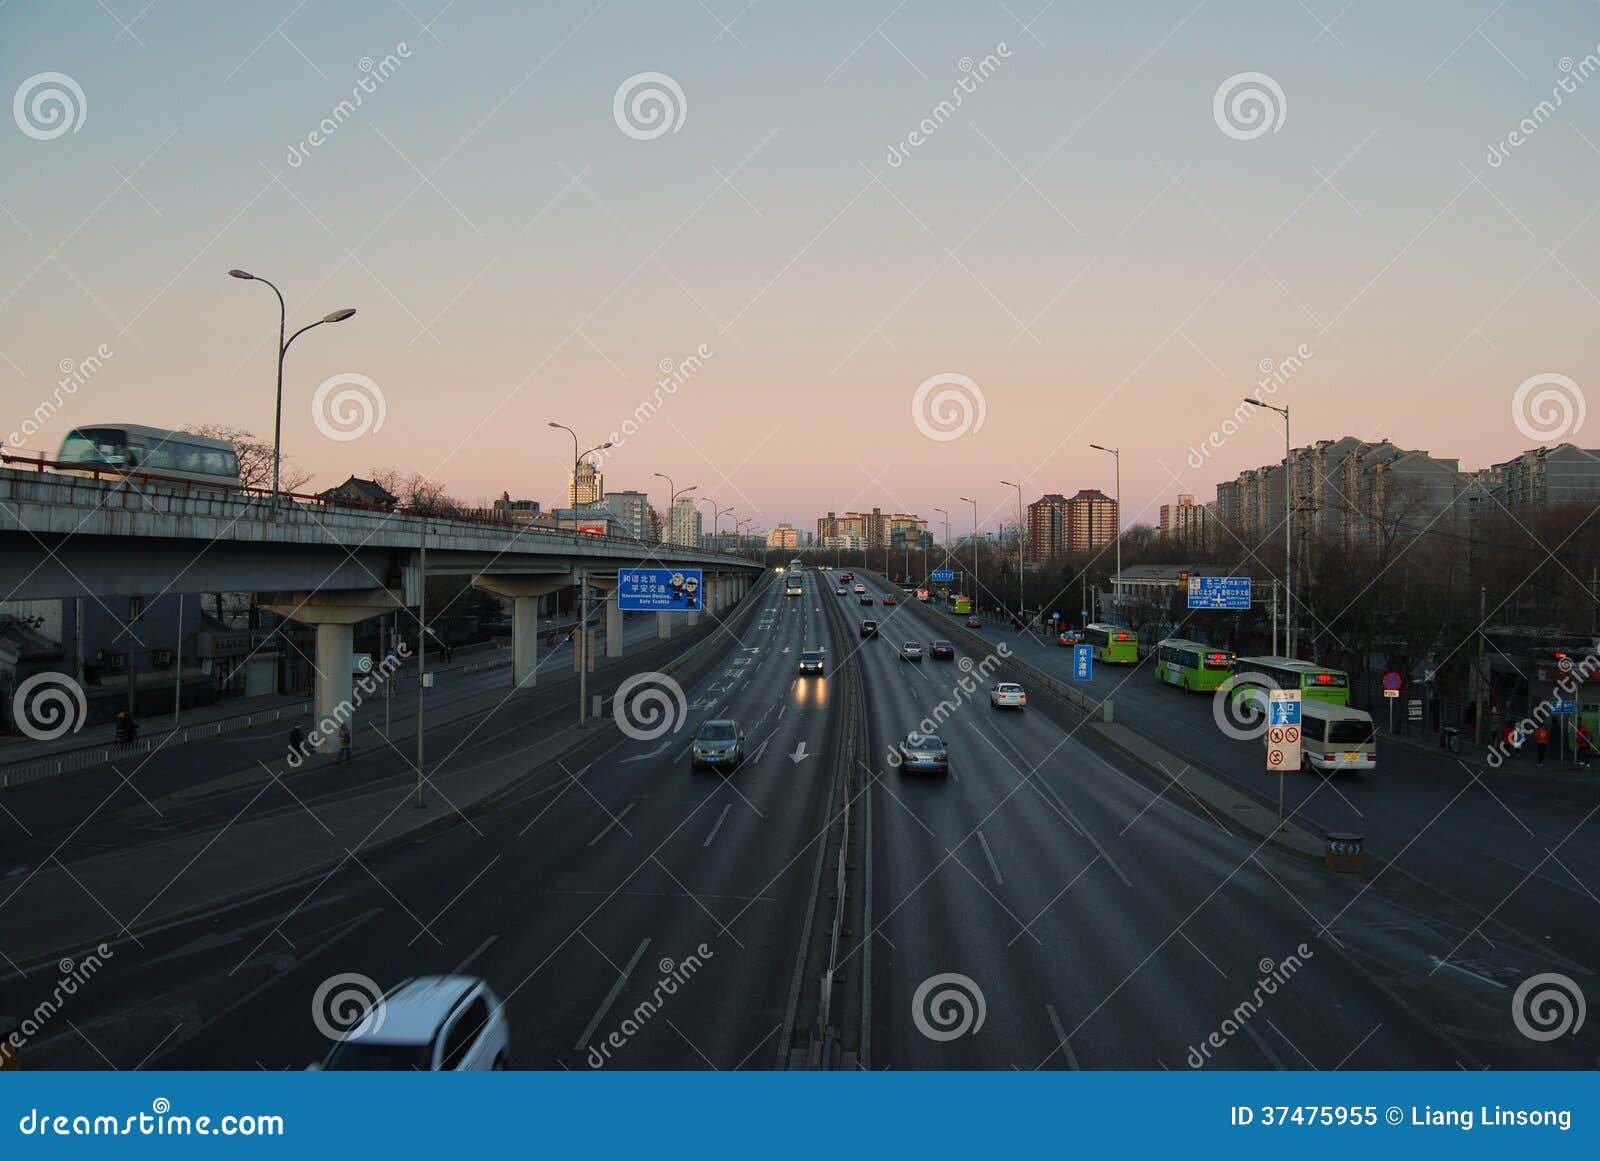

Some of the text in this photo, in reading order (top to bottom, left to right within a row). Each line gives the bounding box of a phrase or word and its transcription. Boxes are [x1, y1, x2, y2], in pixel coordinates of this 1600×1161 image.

[623, 574, 656, 583] 和谐北京
[631, 584, 665, 593] 平安交通
[1277, 702, 1294, 711] 入口
